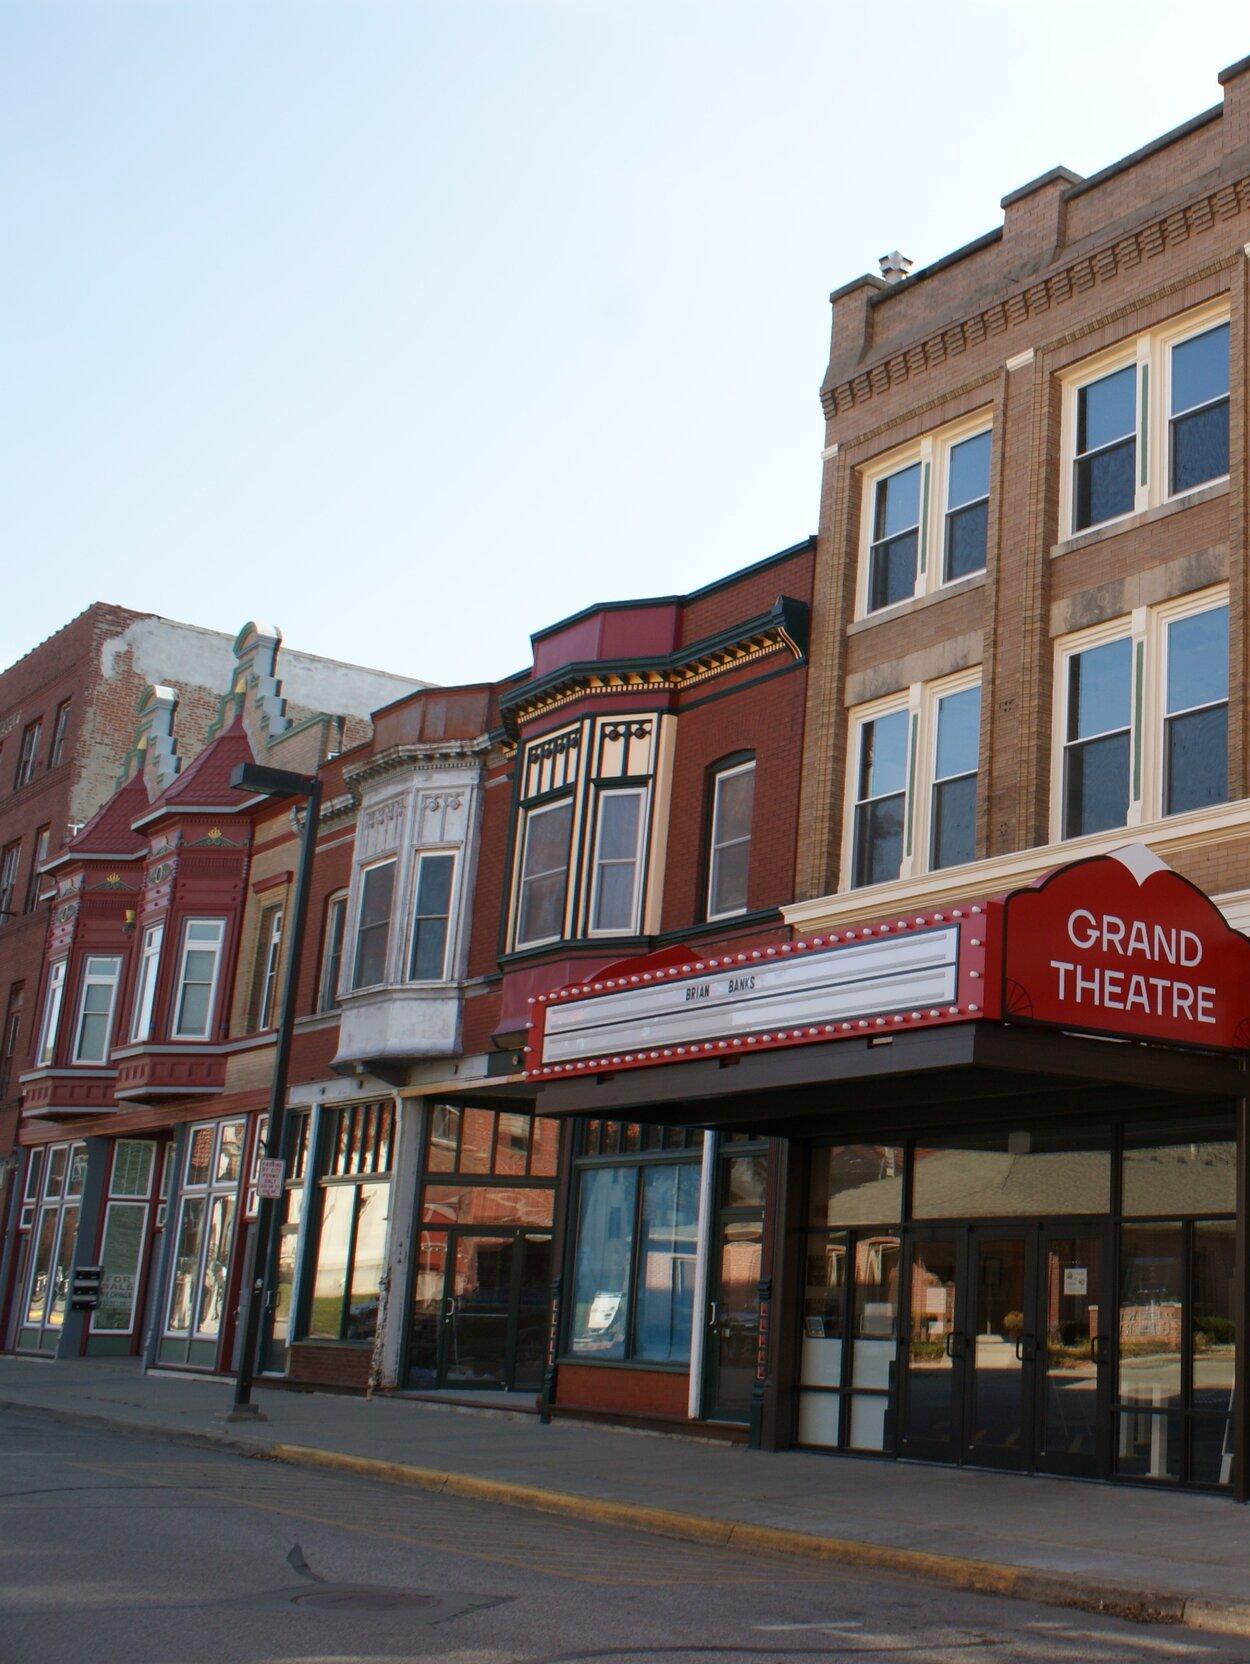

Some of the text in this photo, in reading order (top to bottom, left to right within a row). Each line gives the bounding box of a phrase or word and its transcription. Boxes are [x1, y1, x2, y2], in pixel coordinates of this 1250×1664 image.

[1067, 908, 1203, 968] GRAND
[685, 976, 755, 1001] BRIAN BANKS
[1050, 960, 1217, 1024] THEATRE
